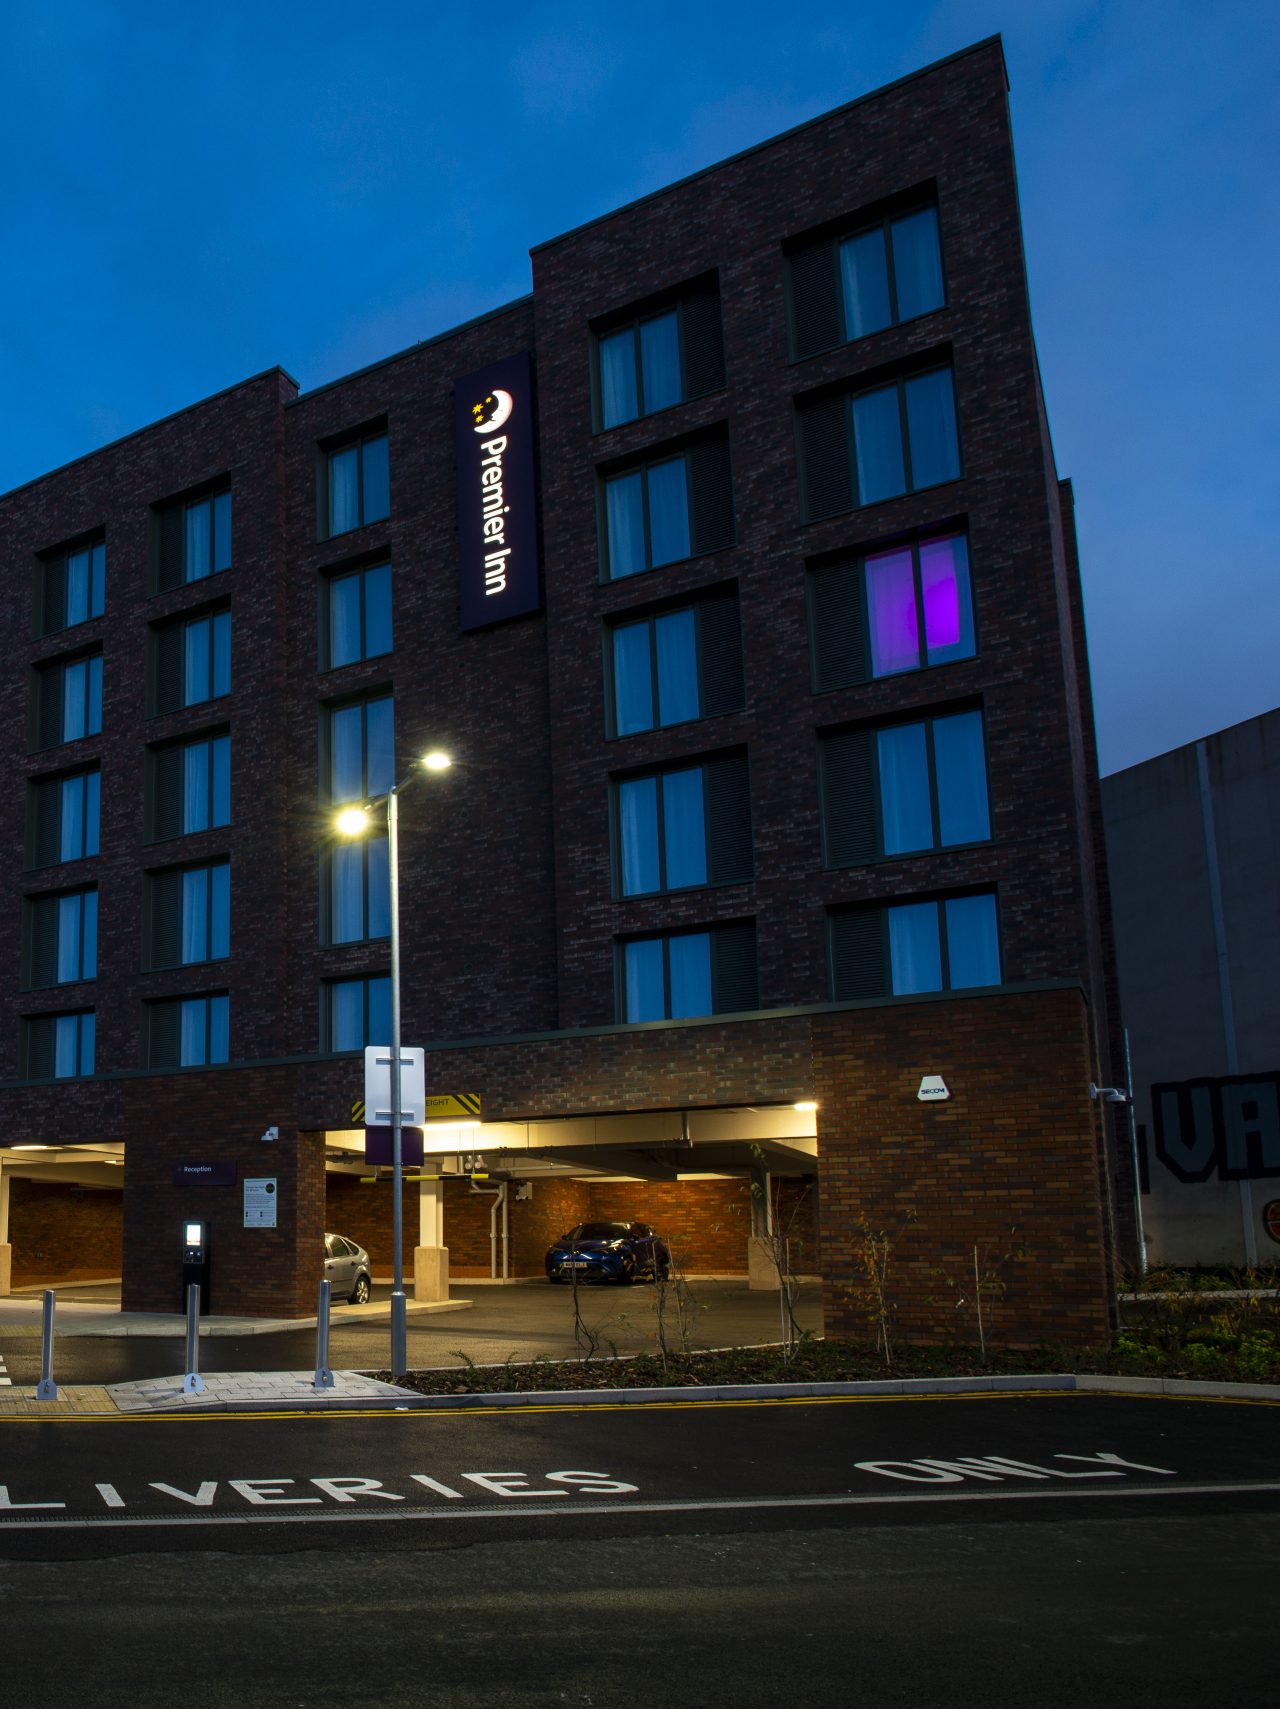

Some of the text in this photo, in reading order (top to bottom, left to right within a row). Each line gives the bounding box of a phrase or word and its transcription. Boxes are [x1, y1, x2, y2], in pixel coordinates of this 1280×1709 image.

[480, 435, 512, 596] Premier Inn
[425, 1098, 449, 1107] EIGHT
[183, 1166, 212, 1174] Reception
[853, 1452, 1179, 1483] ONLY
